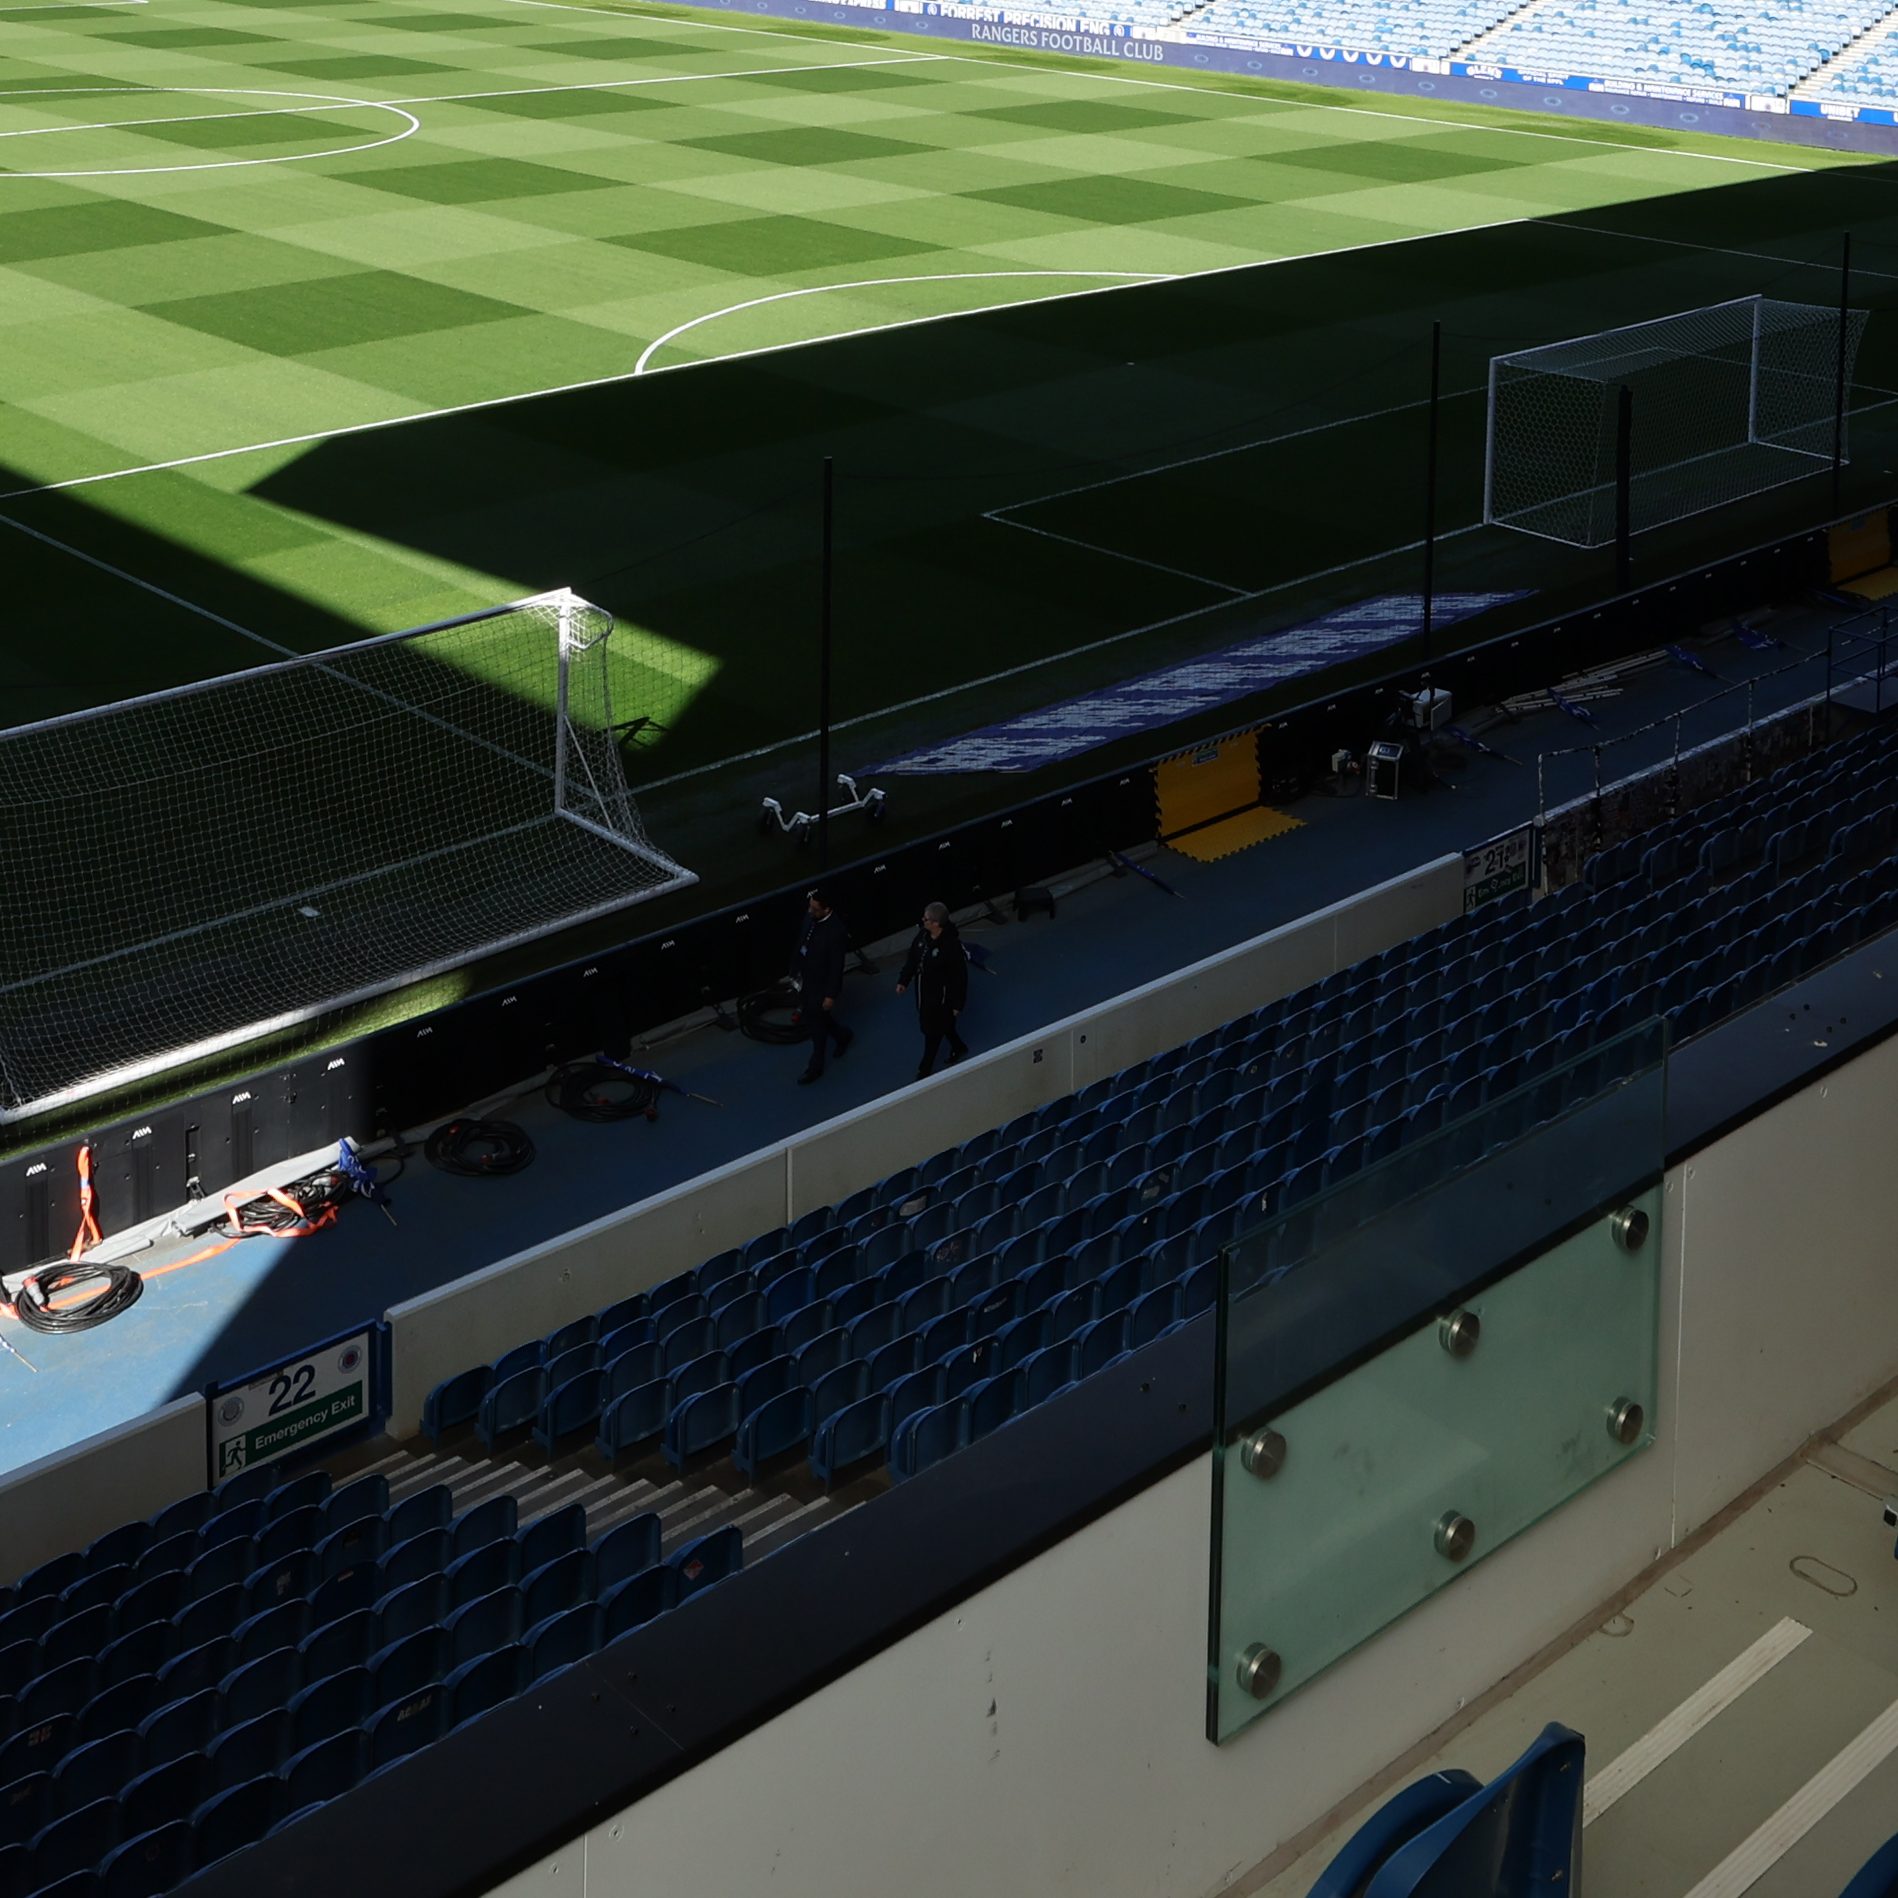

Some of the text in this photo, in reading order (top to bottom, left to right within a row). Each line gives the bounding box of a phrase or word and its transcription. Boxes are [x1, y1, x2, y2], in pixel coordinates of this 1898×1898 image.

[971, 22, 1038, 45] RANGERS
[1041, 30, 1121, 56] FOOTBALL
[1123, 40, 1164, 62] CLUB
[1820, 103, 1860, 118] UNIBET
[1484, 845, 1504, 876] 21
[268, 1364, 316, 1417] 22
[254, 1394, 356, 1450] Emergency Exit
